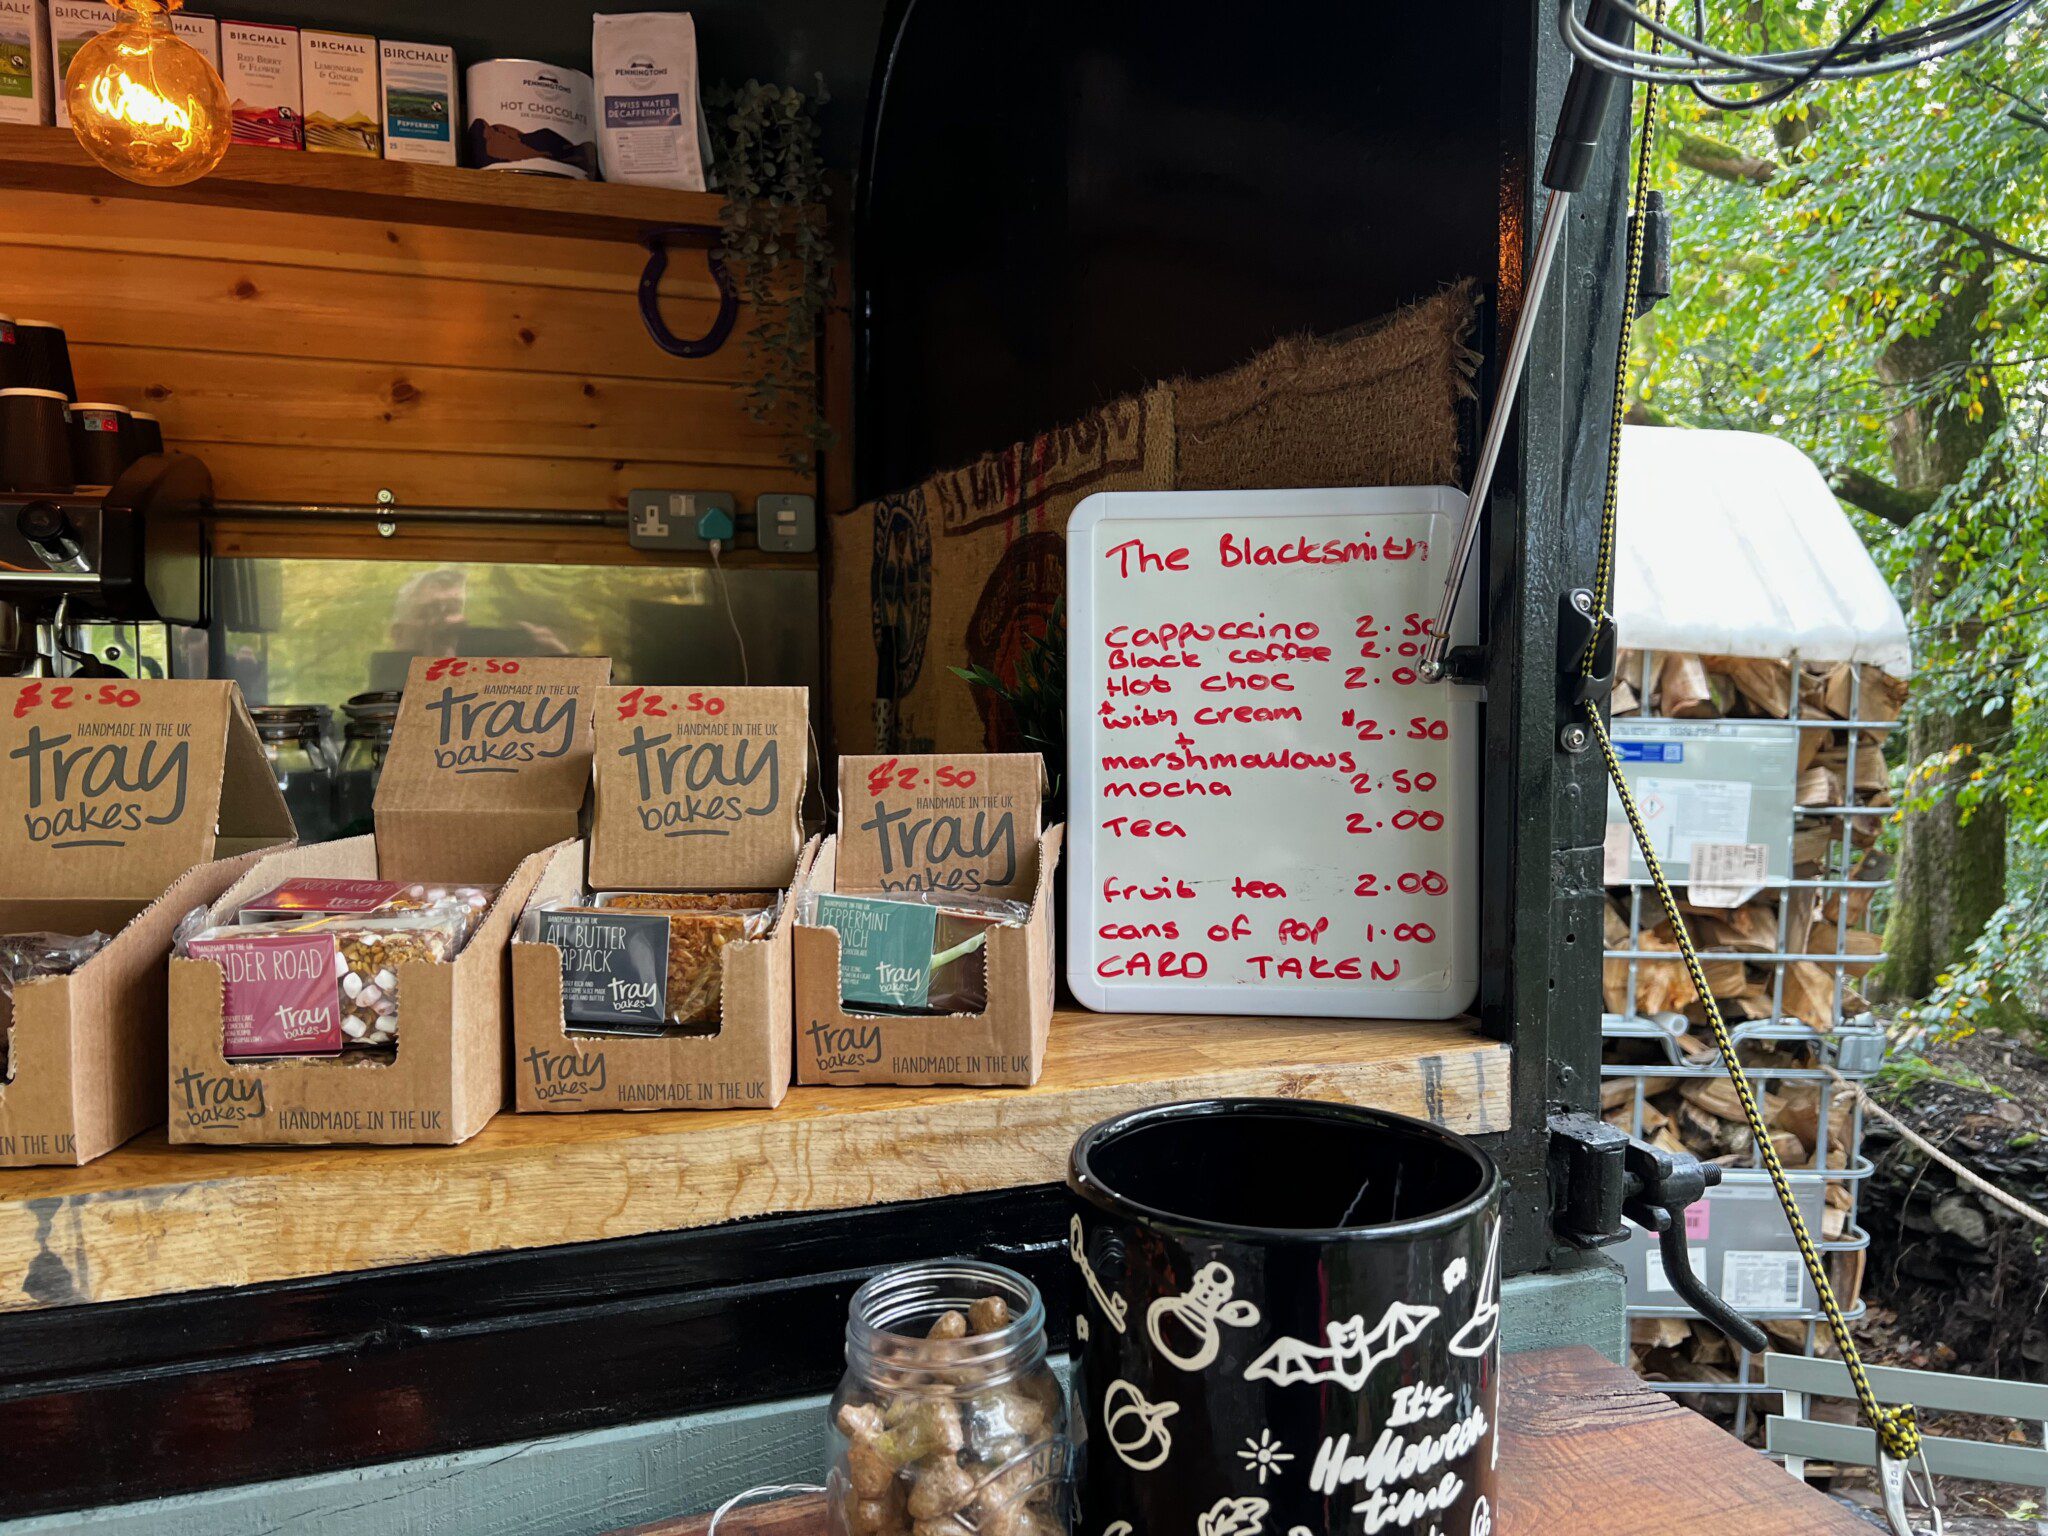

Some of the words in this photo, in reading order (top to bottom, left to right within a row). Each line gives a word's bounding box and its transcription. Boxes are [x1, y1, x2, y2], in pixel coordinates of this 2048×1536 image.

[55, 7, 117, 22] BIRCHAL
[230, 32, 287, 45] BIRCHALL
[310, 40, 366, 54] BIRCHALL
[384, 48, 448, 63] BIRCHALL
[615, 68, 668, 76] PENNINGTONS
[523, 79, 572, 94] PENNINGTONS
[500, 101, 524, 111] HOT
[528, 103, 588, 125] CHOCOLATE
[607, 107, 678, 118] DECAFFEINATED
[614, 101, 641, 109] SWISS
[642, 99, 671, 108] WATER
[397, 120, 440, 130] PEPPERMINT
[1106, 538, 1190, 578] The
[1219, 531, 1429, 568] Blacksmith
[1108, 648, 1201, 670] Black
[1229, 642, 1332, 663] coffee
[1360, 640, 1427, 659] 2.0
[484, 684, 532, 695] HANDMADE
[535, 684, 545, 695] IN
[550, 684, 565, 695] THE
[567, 684, 580, 695] UK
[1107, 673, 1172, 697] Hot
[1200, 672, 1295, 691] choc
[1344, 666, 1417, 690] 2.0
[13, 682, 141, 718] £2.50
[78, 723, 136, 737] HANDMADE
[138, 723, 151, 737] IN
[156, 723, 174, 737] THE
[177, 723, 192, 737] UK
[425, 687, 577, 757] tray
[677, 723, 728, 736] HANDMADE
[731, 723, 742, 736] IN
[746, 723, 762, 736] THE
[765, 723, 778, 736] UK
[1102, 704, 1178, 730] with
[1193, 704, 1302, 726] cream
[1355, 717, 1449, 741] 2.50
[434, 740, 535, 769] bakes
[1101, 748, 1357, 774] marshmallows
[10, 725, 188, 825] tray
[618, 725, 779, 816] tray
[867, 758, 976, 797] £2.50
[1103, 778, 1232, 798] mocha
[1350, 769, 1437, 795] 2.50
[637, 795, 742, 831] bakes
[916, 797, 966, 809] HANDMADE
[969, 797, 979, 809] IN
[982, 797, 998, 809] THE
[1000, 797, 1013, 809] UK
[24, 802, 142, 841] bakes
[1102, 816, 1187, 838] Tea
[1345, 809, 1444, 834] 2.00
[861, 801, 1016, 886] tray
[1103, 876, 1197, 903] fruit
[1231, 876, 1287, 899] tea
[1353, 870, 1449, 897] 2.00
[822, 907, 891, 932] PEPPERMINT
[1098, 921, 1180, 940] cans
[1207, 913, 1252, 941] of
[1366, 922, 1436, 944] 1.00
[546, 924, 569, 948] ALL
[575, 926, 626, 950] BUTTER
[273, 949, 323, 980] ROAD
[562, 949, 613, 973] APJACK
[1096, 951, 1209, 979] CARD
[1246, 955, 1401, 981] TAKEN
[875, 961, 921, 991] tray
[879, 983, 909, 992] bakes
[607, 977, 657, 1008] tray
[613, 999, 645, 1011] bakes
[274, 1005, 331, 1033] tray
[284, 1026, 320, 1039] bakes
[806, 1020, 882, 1063] tray
[523, 1046, 606, 1092] tray
[816, 1053, 864, 1070] bakes
[893, 1056, 961, 1074] HANDMADE
[966, 1056, 980, 1072] IN
[986, 1056, 1007, 1072] THE
[1012, 1055, 1029, 1072] UK
[174, 1067, 265, 1119] tray
[534, 1081, 588, 1100] bakes
[618, 1083, 692, 1102] HANDMADE
[698, 1083, 713, 1100] IN
[718, 1083, 741, 1100] THE
[746, 1082, 764, 1099] UK
[187, 1104, 246, 1126] bakes
[279, 1111, 361, 1130] HANDMADE
[367, 1111, 384, 1130] IN
[390, 1111, 415, 1130] THE
[421, 1111, 441, 1130] UK
[21, 1135, 48, 1155] THE
[54, 1134, 76, 1154] UK
[1386, 1380, 1454, 1427] It's
[1309, 1405, 1488, 1495] Halloween
[1352, 1471, 1464, 1535] time
